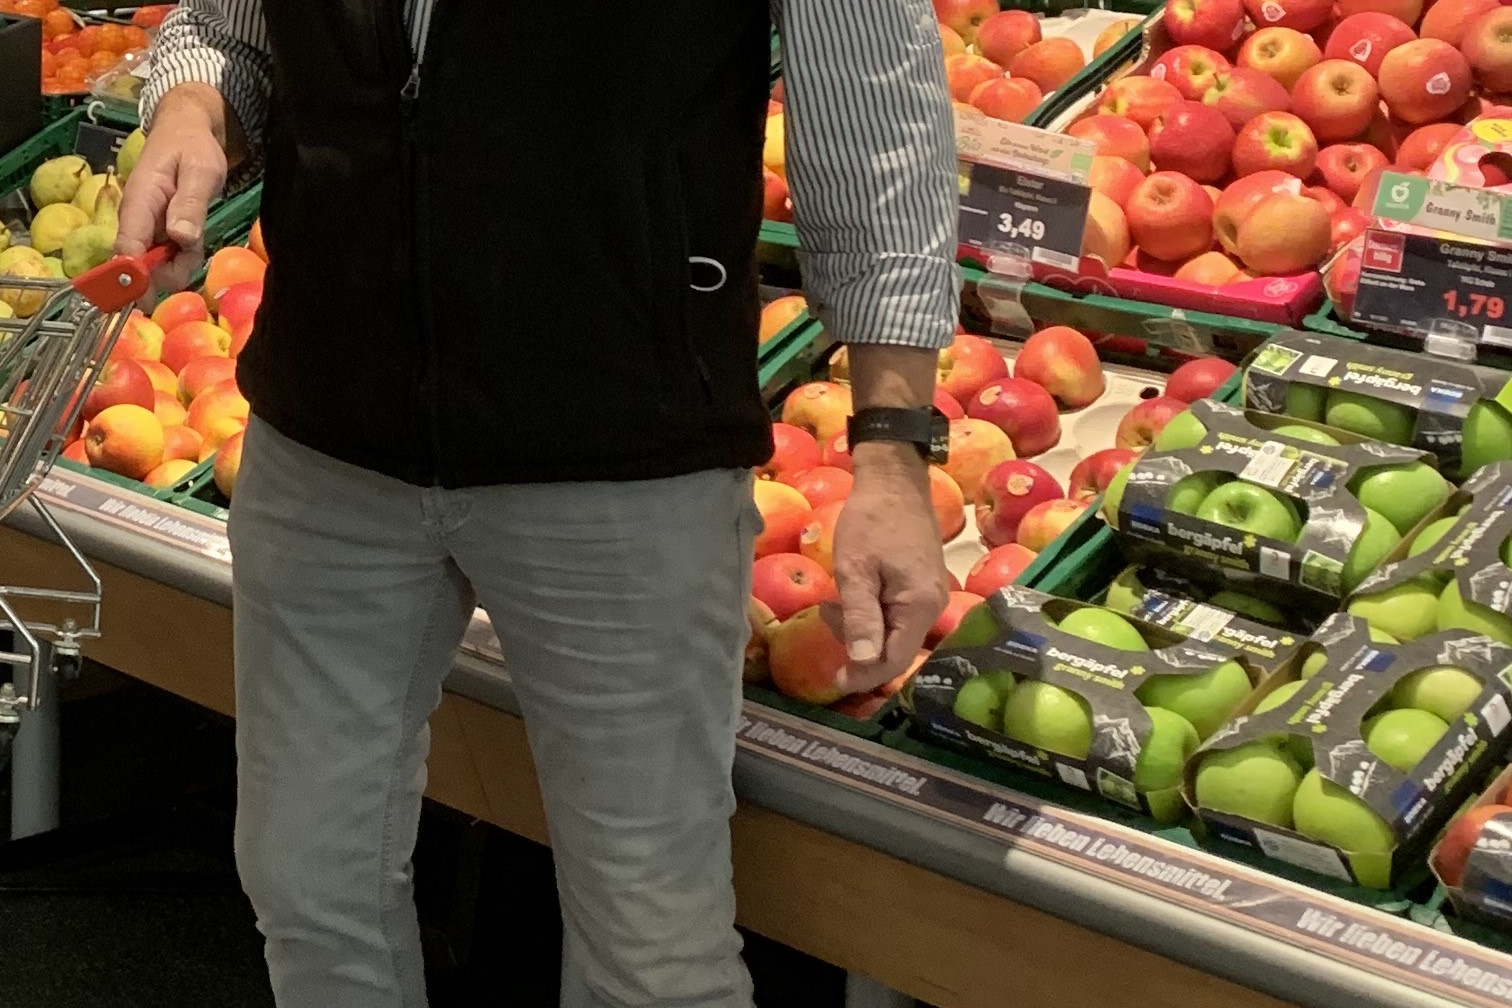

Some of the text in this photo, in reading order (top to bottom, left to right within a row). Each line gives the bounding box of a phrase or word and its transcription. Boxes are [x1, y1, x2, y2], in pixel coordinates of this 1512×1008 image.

[997, 212, 1045, 241] 3,49
[1425, 202, 1462, 222] Granny
[1465, 209, 1496, 225] Smith
[1440, 244, 1484, 262] Granny
[1443, 289, 1505, 318] 1,79
[1343, 370, 1422, 396] bergäpfel
[1167, 522, 1243, 556] bergäpfel
[1045, 647, 1129, 679] bergäpfel
[1306, 673, 1365, 724] bergäpfel
[744, 721, 808, 753] lieben
[1423, 727, 1479, 792] bergäpfel
[983, 802, 1233, 901] Wir lieben Lebensmittel.
[1296, 906, 1344, 938] Wir
[1339, 922, 1423, 966] lieben
